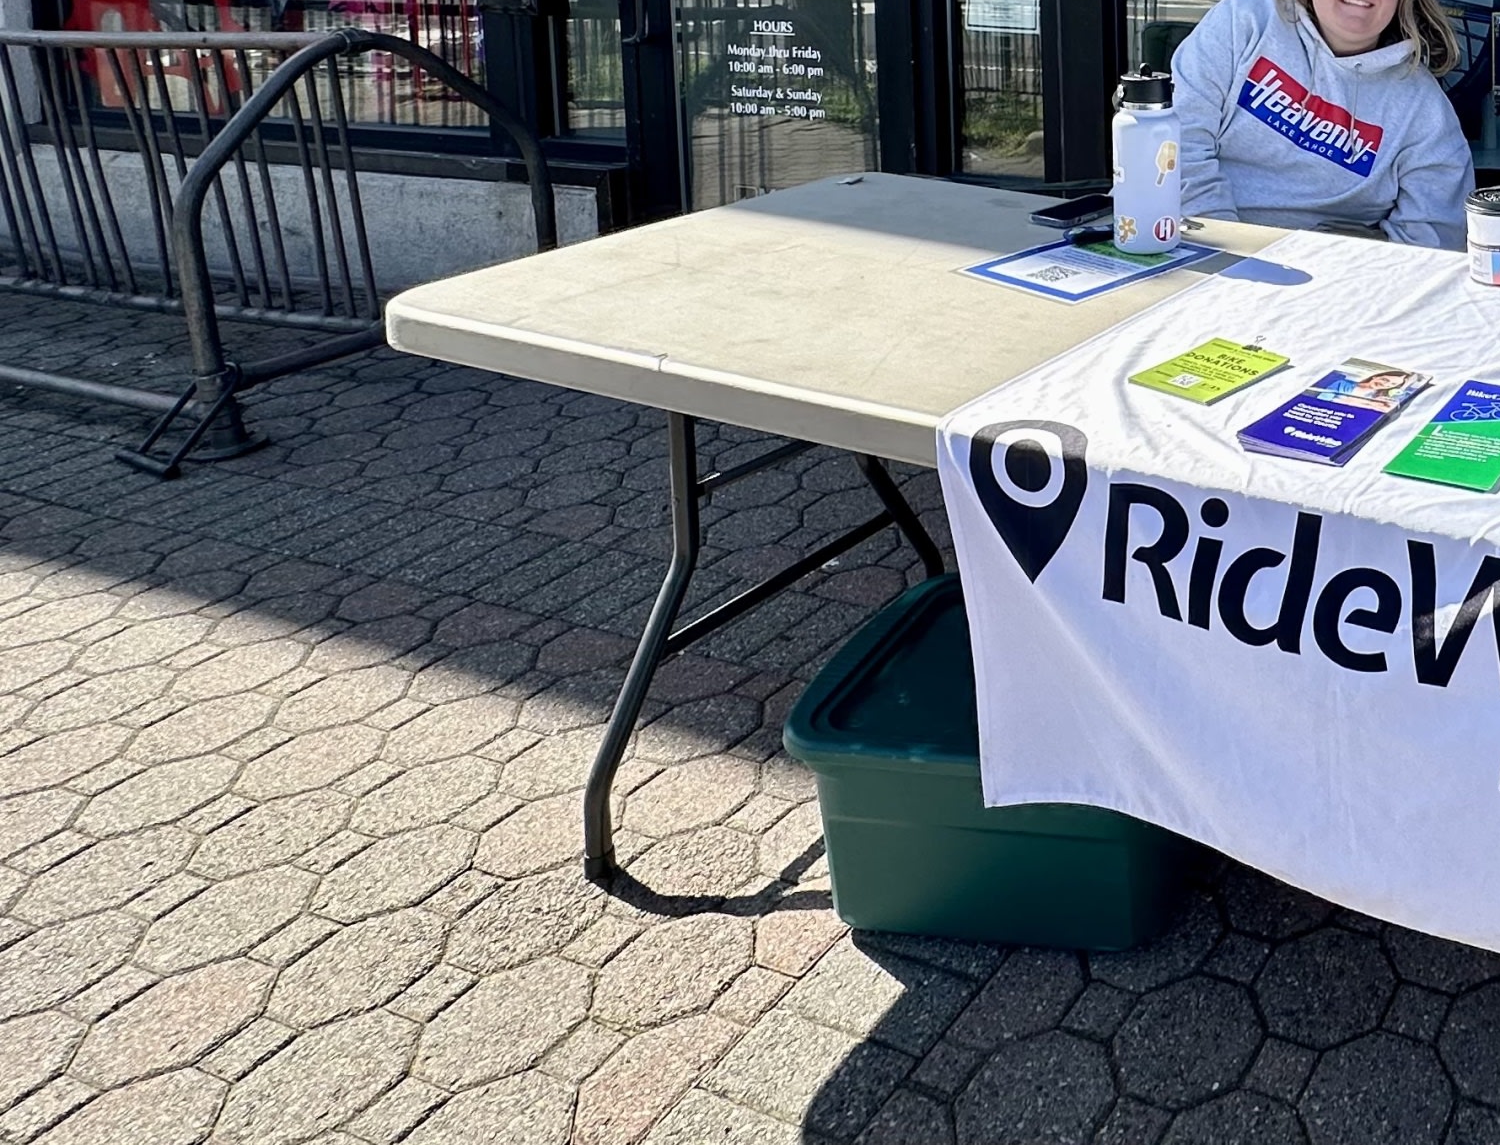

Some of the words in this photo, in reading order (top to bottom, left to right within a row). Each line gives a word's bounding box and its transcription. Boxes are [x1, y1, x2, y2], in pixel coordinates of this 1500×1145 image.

[753, 20, 794, 33] HOURS
[727, 44, 766, 60] Monday
[768, 45, 790, 58] thru
[792, 46, 822, 63] Friday
[728, 61, 756, 73] 10:00
[757, 65, 774, 74] am
[782, 63, 805, 76] 6:00
[807, 67, 824, 79] pm
[731, 85, 774, 103] Saturday
[775, 88, 784, 99] &
[786, 88, 823, 104] Sunday
[730, 102, 758, 114] 10:00
[760, 106, 775, 115] am
[784, 105, 807, 117] 5:00
[808, 109, 826, 121] pm
[1249, 68, 1375, 165] Heavenly
[1266, 115, 1295, 137] LAKE
[1298, 136, 1334, 157] TAHOE
[1159, 218, 1172, 241] H
[1185, 352, 1260, 377] DONATIONS
[1216, 353, 1247, 364] BIKE
